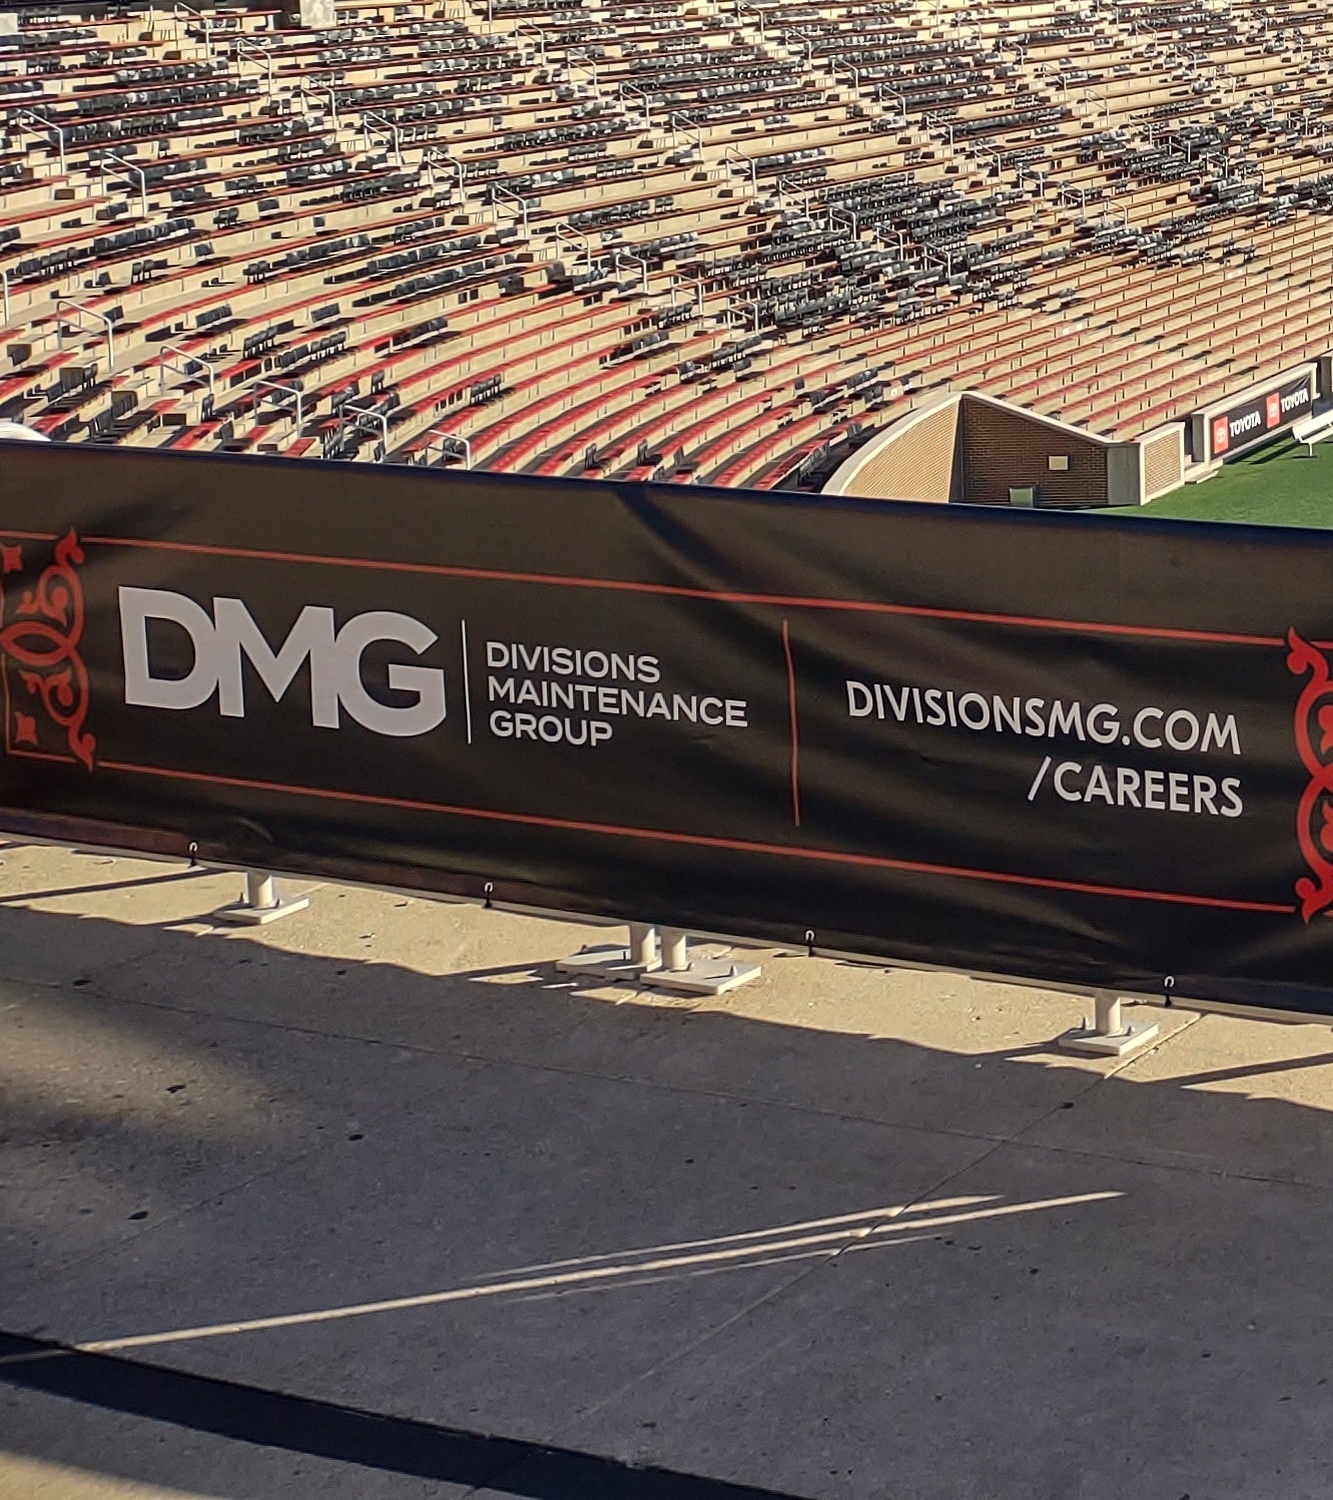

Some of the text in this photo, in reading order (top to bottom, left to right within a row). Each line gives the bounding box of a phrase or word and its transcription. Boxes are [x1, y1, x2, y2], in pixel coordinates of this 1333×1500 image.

[1229, 387, 1309, 437] TOYOTA TOYOTA
[118, 584, 447, 738] DMG
[485, 641, 662, 684] DIVISIONS
[487, 676, 749, 729] MAINTENANCE
[489, 710, 614, 748] GROUP
[846, 680, 1242, 756] DIVISIONSMG.COM
[1026, 755, 1244, 818] /CAREERS
